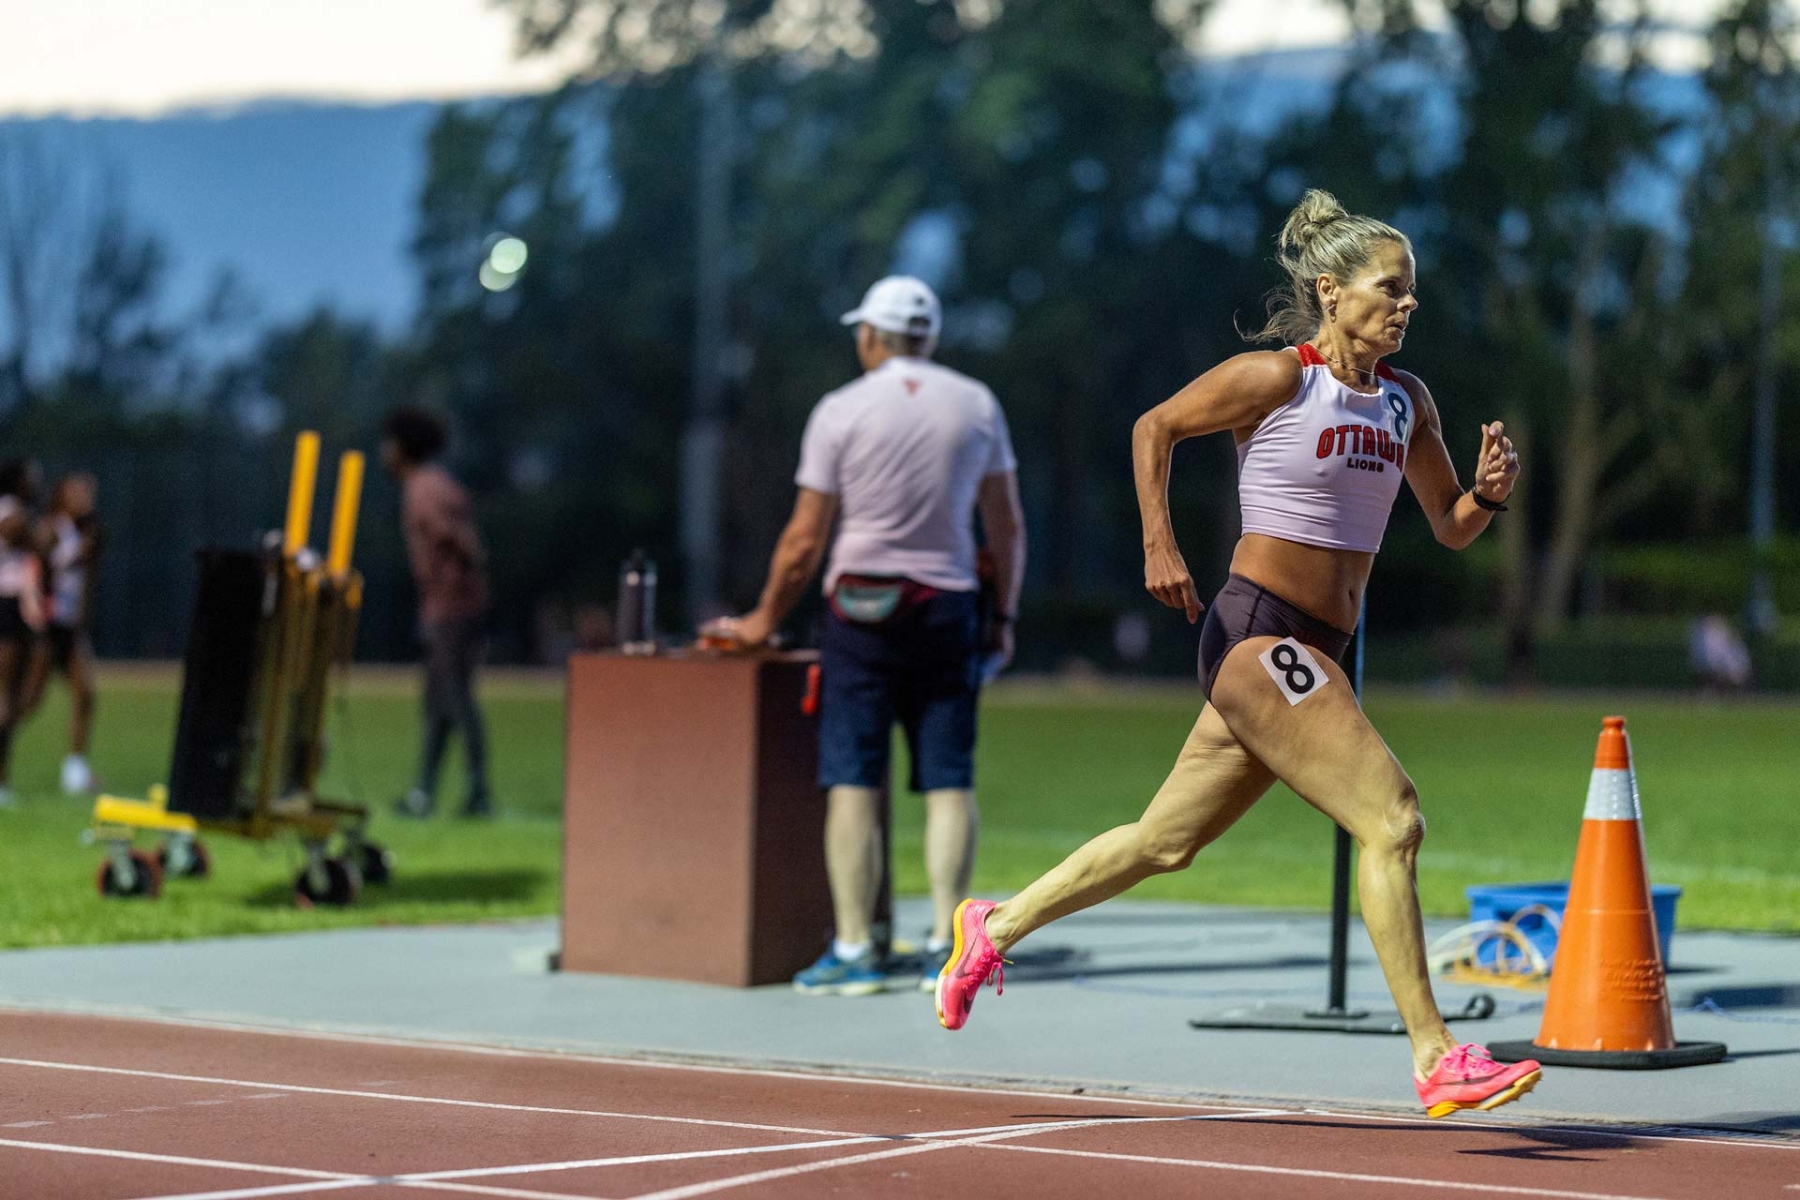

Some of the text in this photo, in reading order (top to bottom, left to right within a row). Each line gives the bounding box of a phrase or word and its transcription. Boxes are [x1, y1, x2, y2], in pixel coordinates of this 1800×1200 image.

[1388, 393, 1408, 443] 8
[1346, 457, 1384, 473] LIONS
[1271, 644, 1315, 694] 8
